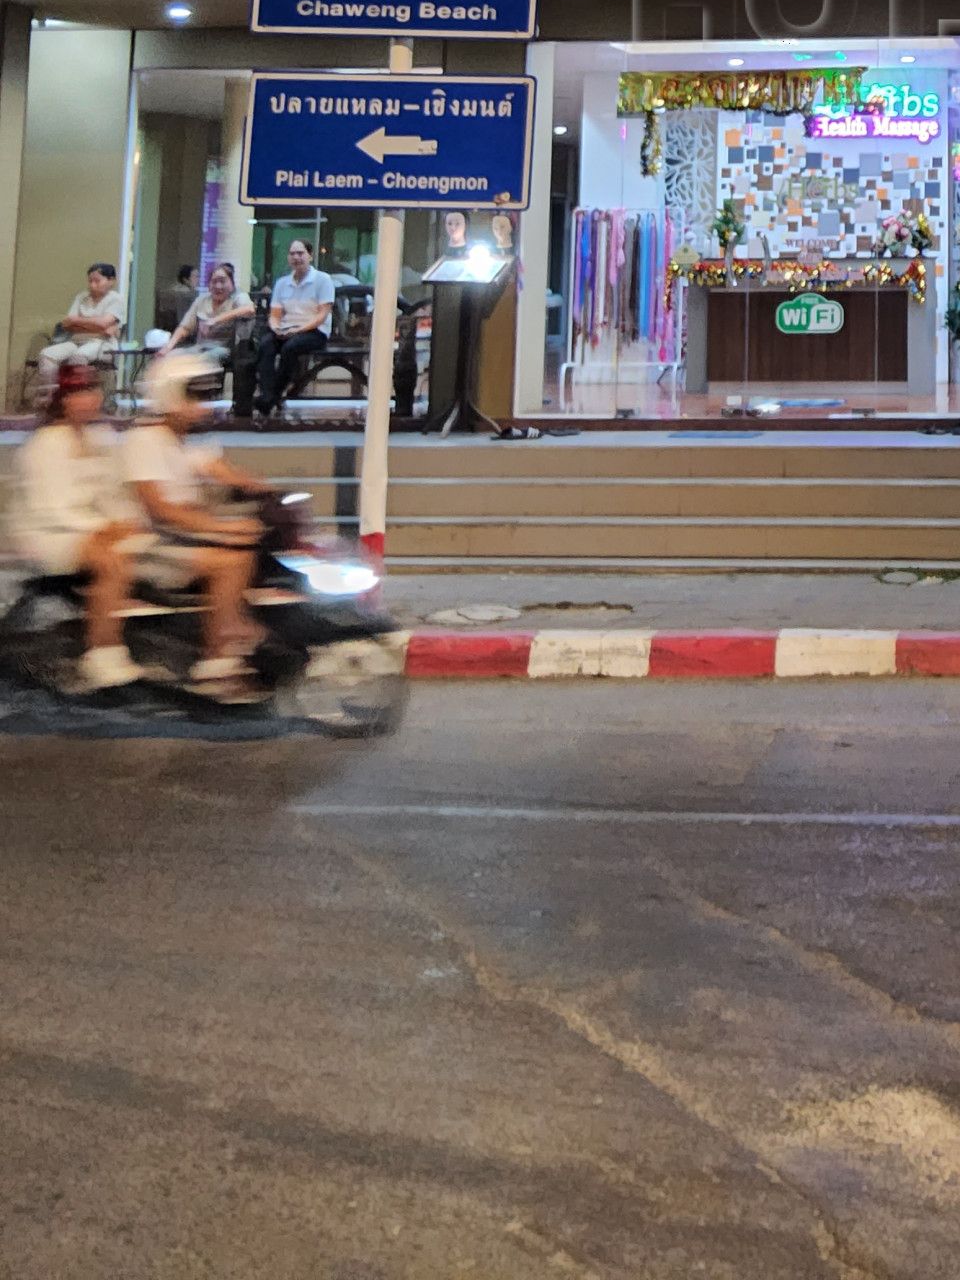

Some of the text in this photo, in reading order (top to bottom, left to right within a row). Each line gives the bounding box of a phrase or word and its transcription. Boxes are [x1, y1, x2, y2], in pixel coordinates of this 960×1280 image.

[296, 0, 498, 22] Chaweng Beach
[872, 116, 940, 143] Massage
[275, 170, 309, 189] Plai
[313, 171, 363, 189] Laem
[382, 171, 489, 194] Choengmon
